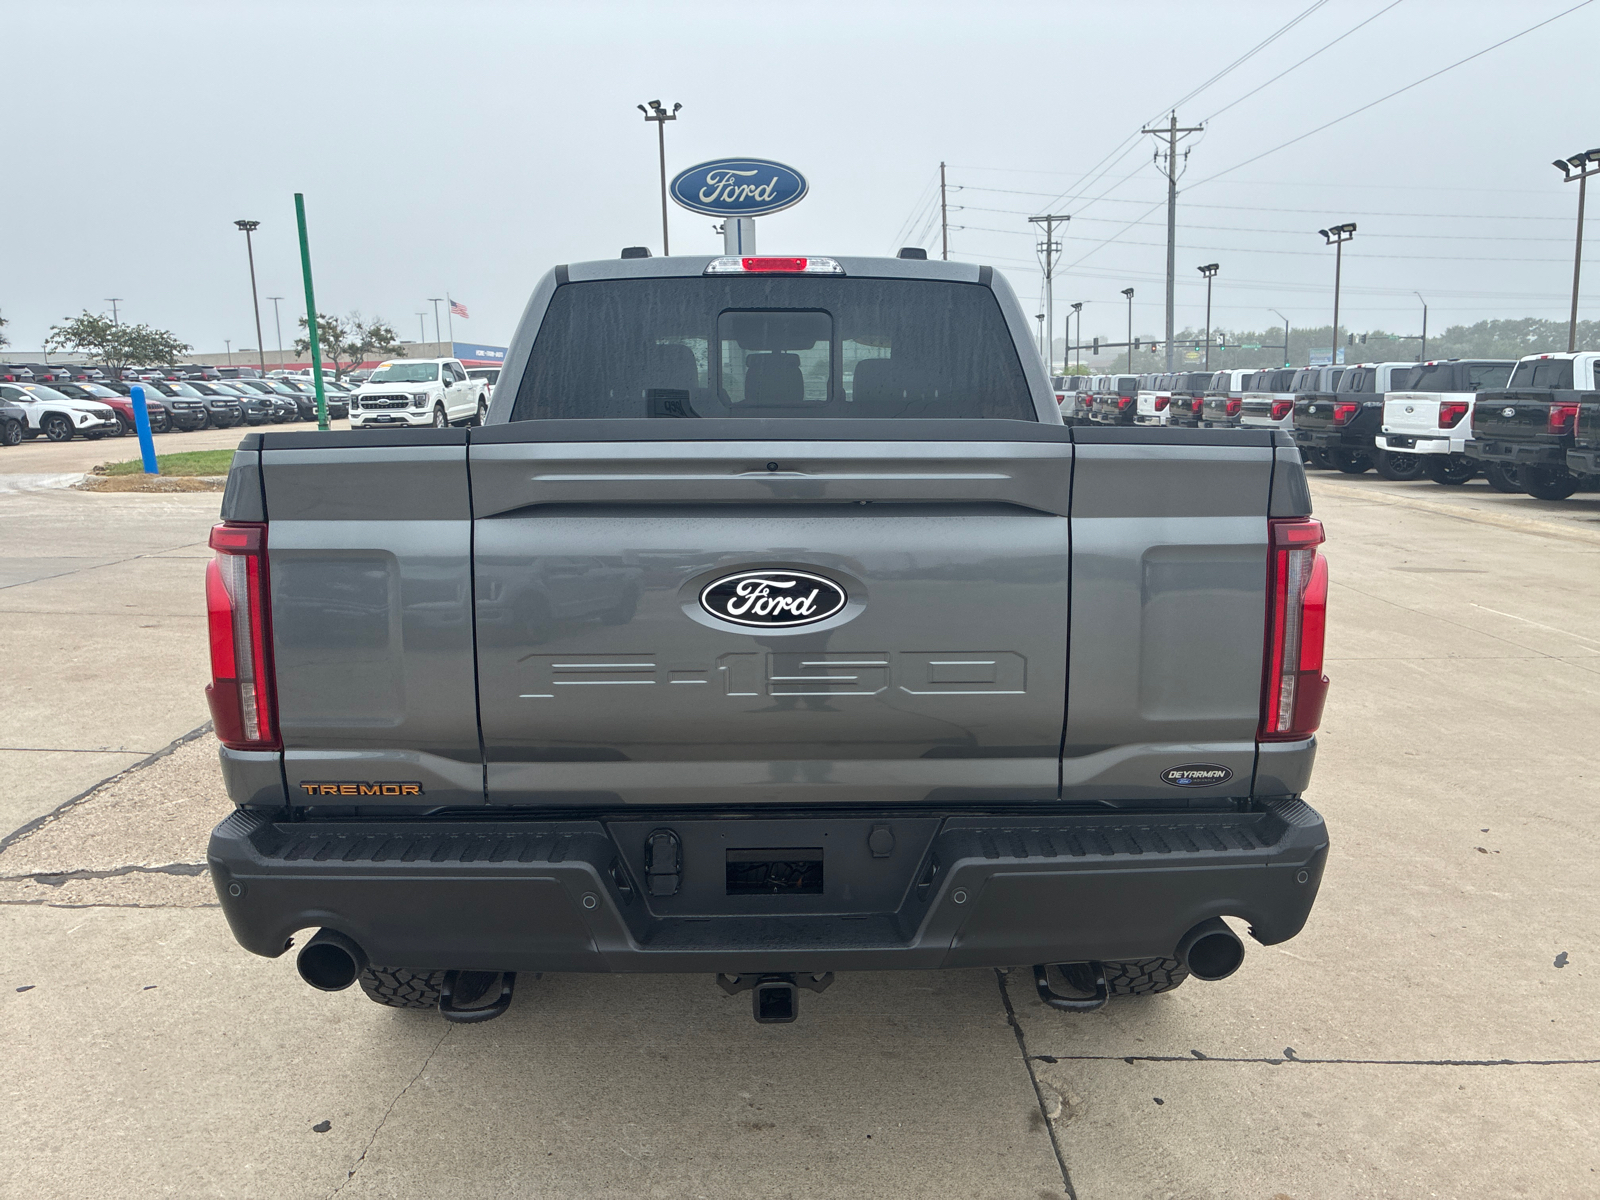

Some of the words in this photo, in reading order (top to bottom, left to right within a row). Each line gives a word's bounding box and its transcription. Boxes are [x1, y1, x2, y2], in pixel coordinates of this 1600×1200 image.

[699, 169, 779, 203] Ford
[727, 579, 819, 616] Ford
[517, 651, 1028, 698] F-150
[300, 782, 421, 796] TREMOR
[1168, 770, 1226, 779] DEYARMAN
